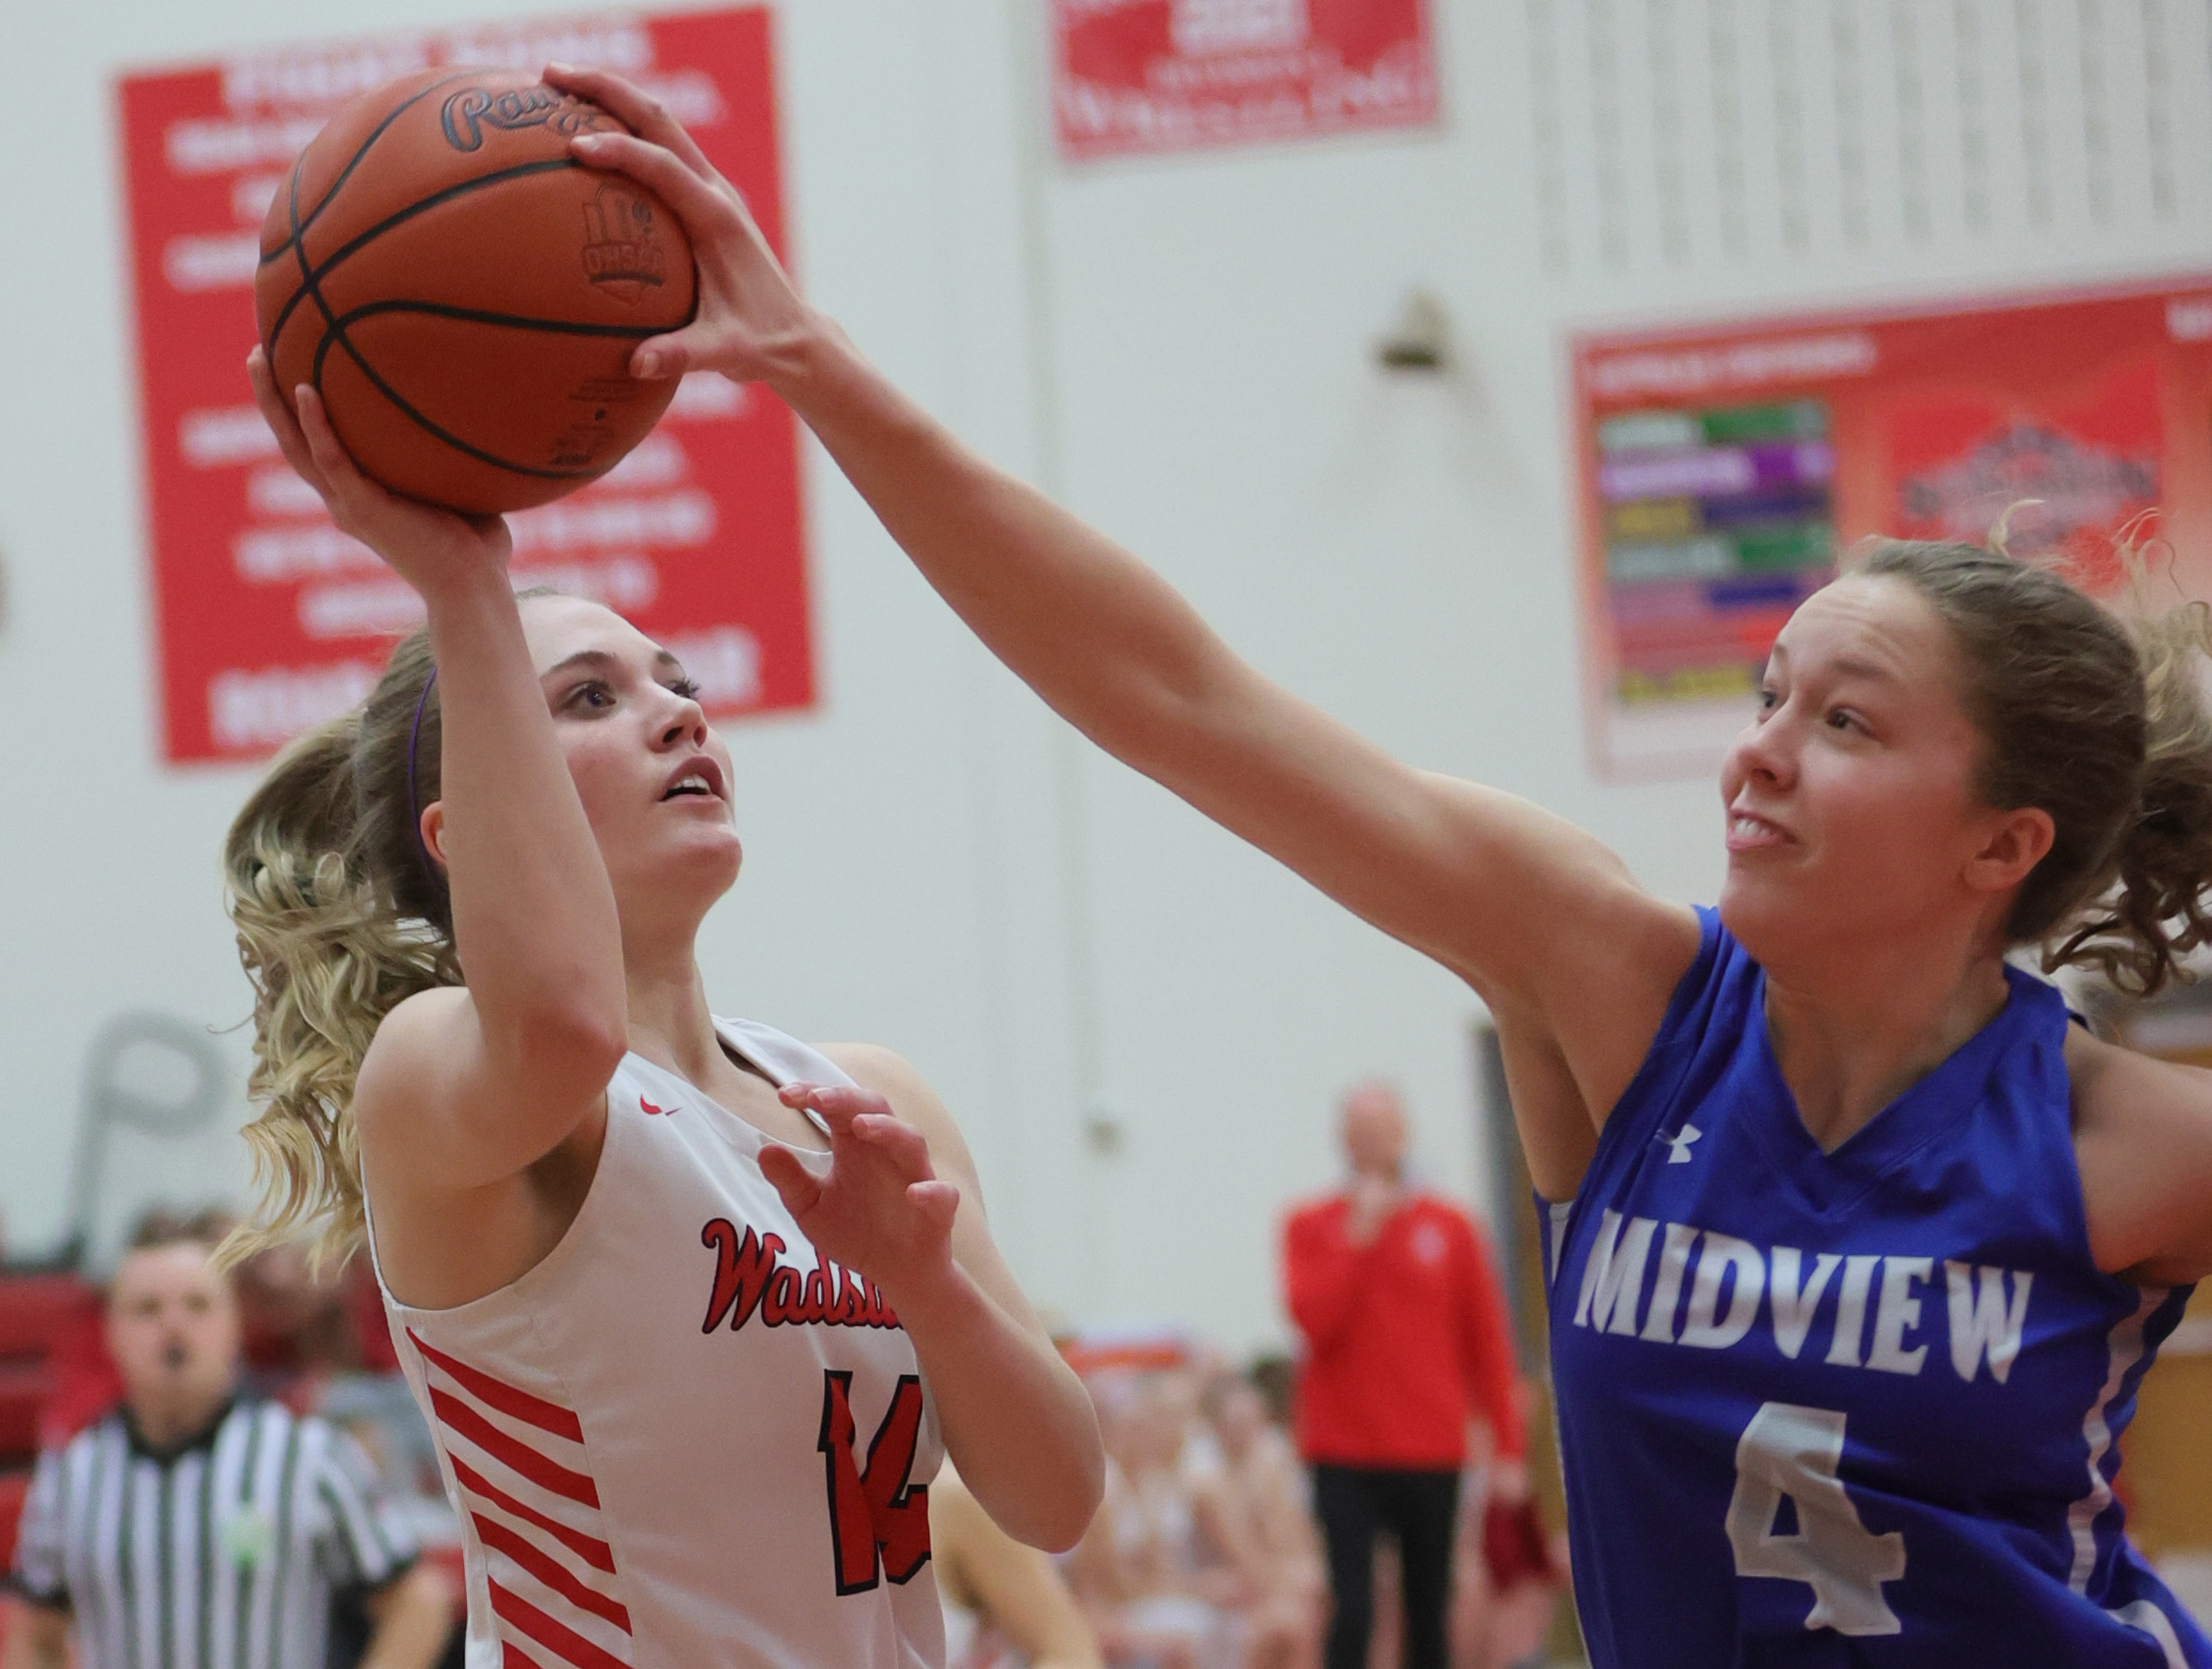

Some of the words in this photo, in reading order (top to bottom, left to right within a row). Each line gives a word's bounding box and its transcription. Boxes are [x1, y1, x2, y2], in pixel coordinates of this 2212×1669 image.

[1574, 1208, 2034, 1384] MIDVIEW
[817, 1369, 932, 1596] 14
[1724, 1401, 1906, 1636] 4
